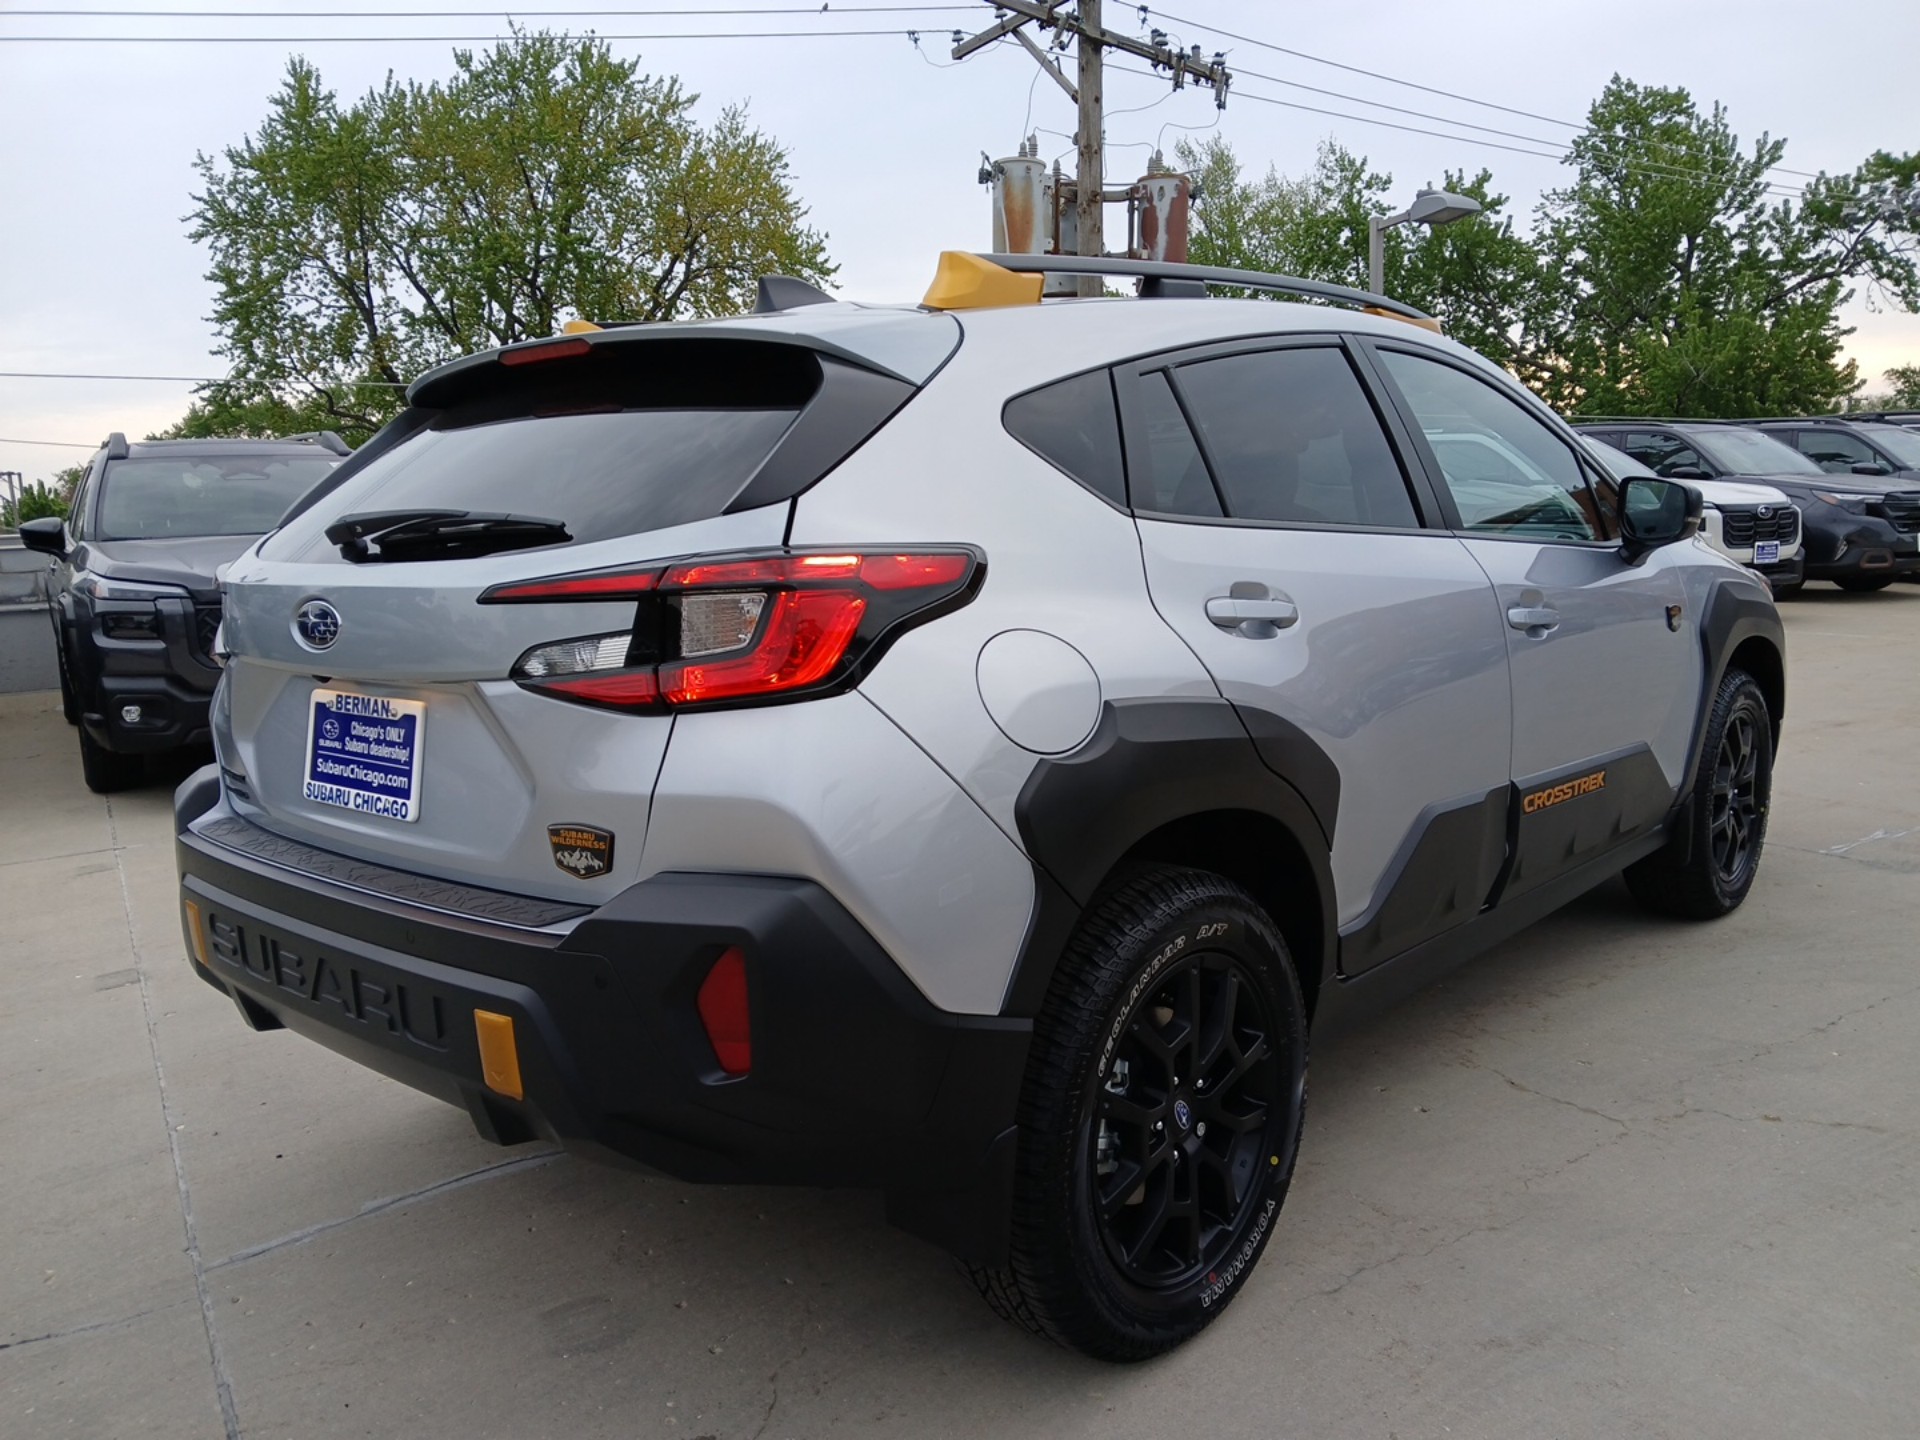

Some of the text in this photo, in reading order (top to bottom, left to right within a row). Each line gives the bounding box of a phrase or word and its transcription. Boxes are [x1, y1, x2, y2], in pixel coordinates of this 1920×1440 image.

[335, 693, 391, 718] BERMAN
[318, 738, 343, 749] SUBARU
[351, 720, 406, 742] Chicago's ONLY
[344, 736, 410, 764] Subaru dealership!
[316, 758, 409, 789] SubaruChicago.com
[306, 782, 409, 819] SUBARU CHICAGO
[1523, 770, 1606, 813] CROSSTREK
[551, 835, 607, 849] WILDERNESS
[560, 829, 596, 840] SUBARU
[1196, 923, 1228, 940] A/T
[209, 912, 449, 1052] SUBARU
[1200, 1198, 1276, 1308] YOKOHAMA
